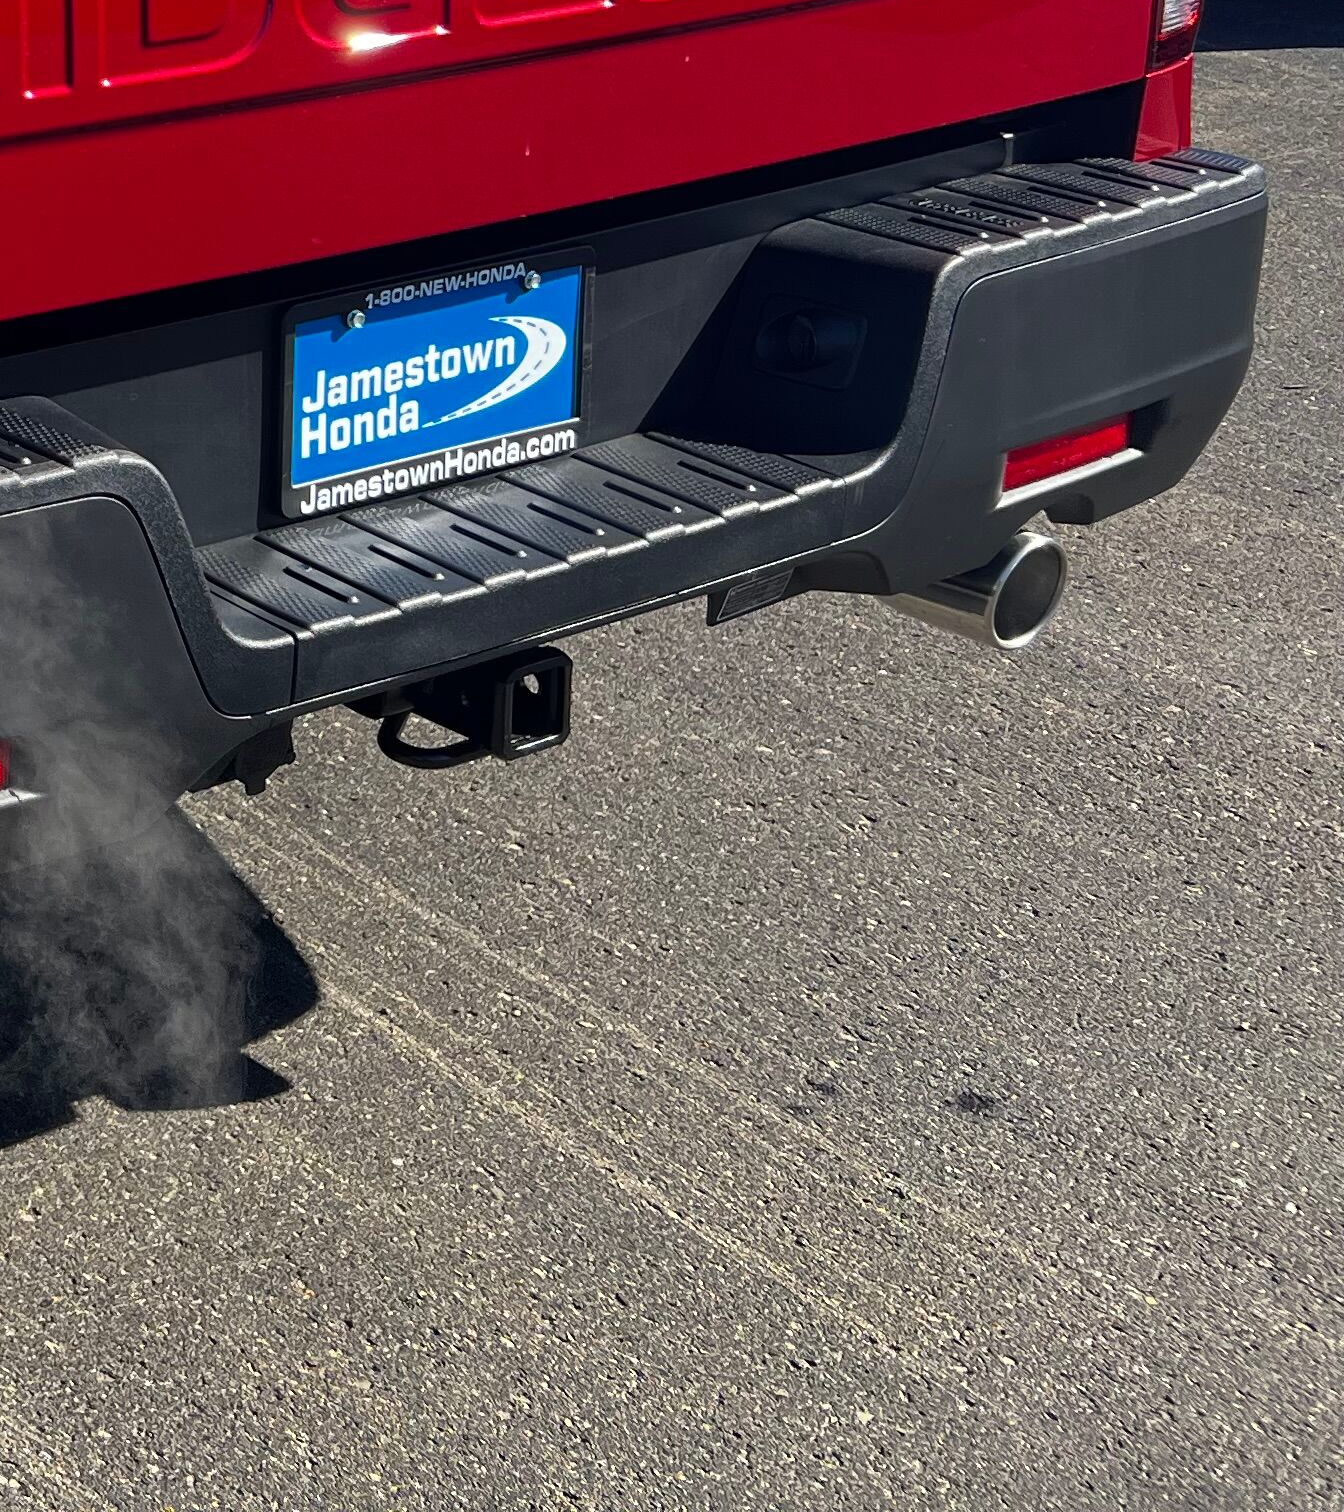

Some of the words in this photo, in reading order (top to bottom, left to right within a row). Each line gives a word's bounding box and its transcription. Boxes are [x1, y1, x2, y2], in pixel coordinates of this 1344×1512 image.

[364, 262, 527, 309] 1-800-NEW-HONDA
[301, 335, 516, 414] Jamestown
[300, 394, 420, 460] Honda
[299, 428, 576, 516] JamestownHonda.com
